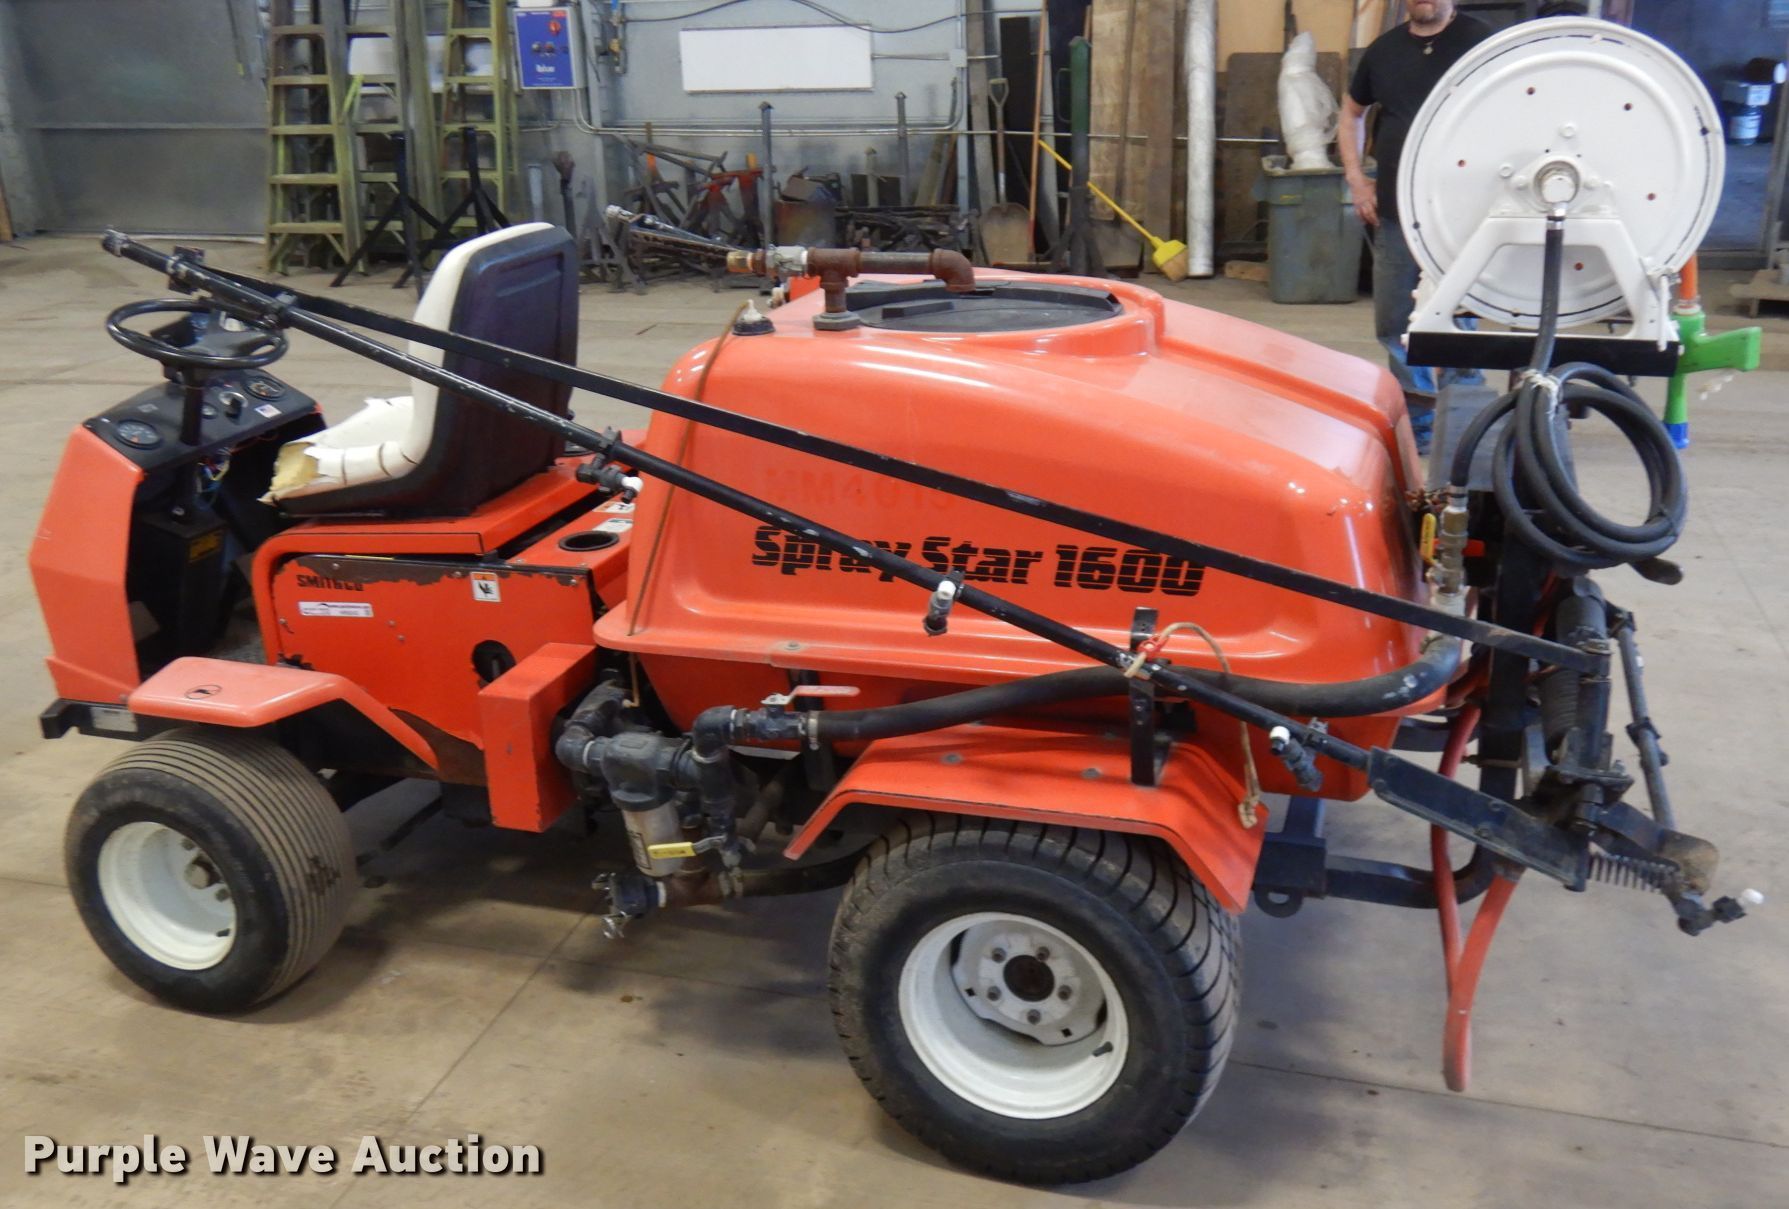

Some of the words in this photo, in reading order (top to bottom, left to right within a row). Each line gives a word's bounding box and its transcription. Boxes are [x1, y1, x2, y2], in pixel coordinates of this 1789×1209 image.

[752, 525, 912, 582] Spray
[921, 536, 1044, 585] Star
[1053, 544, 1206, 597] 1600
